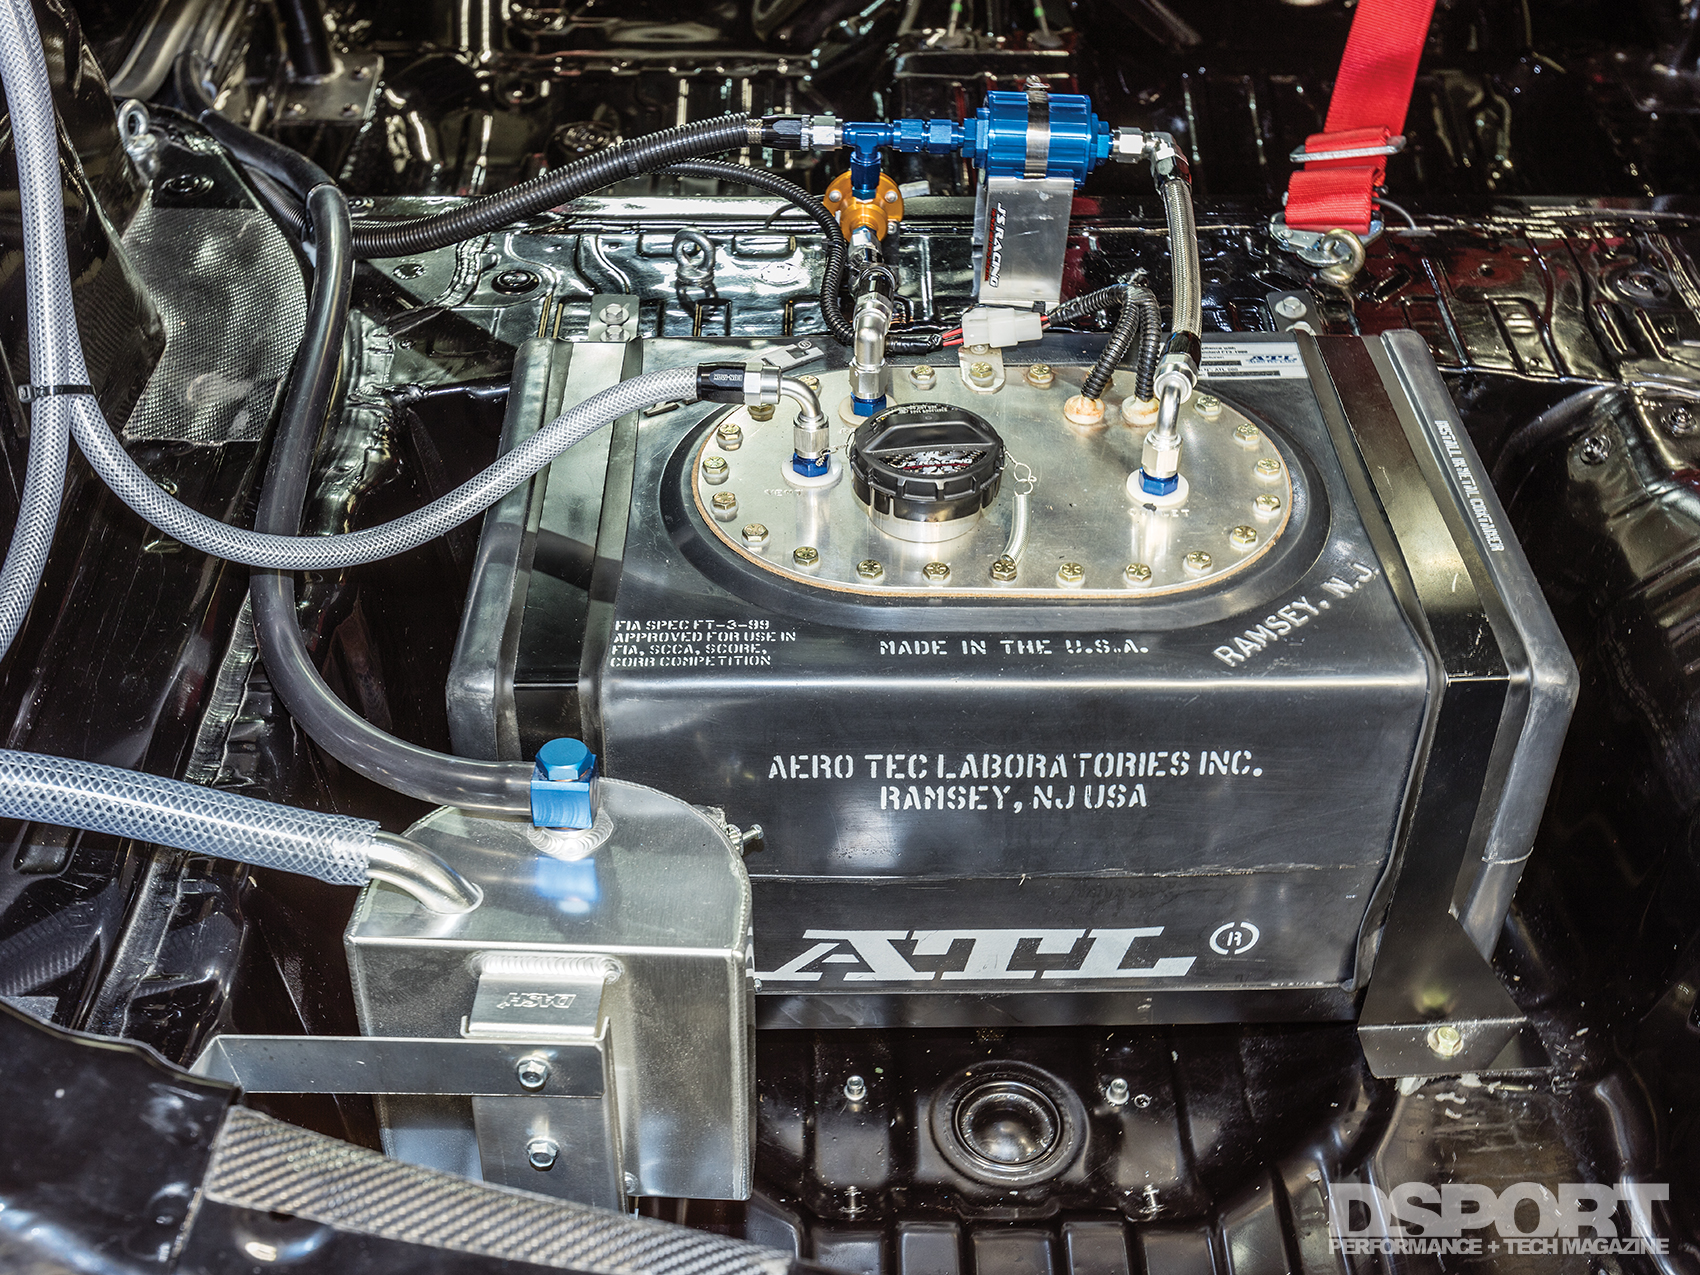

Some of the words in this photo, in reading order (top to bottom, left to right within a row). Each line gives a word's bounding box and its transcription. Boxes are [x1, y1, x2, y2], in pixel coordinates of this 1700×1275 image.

[989, 226, 1005, 288] RACING
[614, 620, 642, 631] FIA
[645, 620, 690, 631] SPEC
[692, 619, 770, 631] FT-3-99
[613, 632, 703, 643] APPROVED
[706, 632, 740, 642] FOR
[743, 631, 777, 642] USE
[780, 631, 796, 642] IN
[611, 644, 645, 656] FIA,
[705, 643, 768, 655] SCORE,
[880, 640, 948, 655] MADE
[961, 640, 987, 655] IN
[1000, 639, 1052, 655] THE
[1065, 638, 1149, 654] U.S.A.
[659, 655, 771, 667] COMPETITION
[768, 754, 854, 780] AERO
[863, 753, 928, 779] TEC
[937, 751, 1190, 779] LABORATORIES
[1199, 750, 1264, 777] INC.
[880, 785, 1024, 815] RAMSEY,
[1032, 785, 1076, 810] NJ
[1083, 783, 1148, 810] USA
[753, 926, 1197, 982] ATL
[499, 992, 577, 1009] DASH
